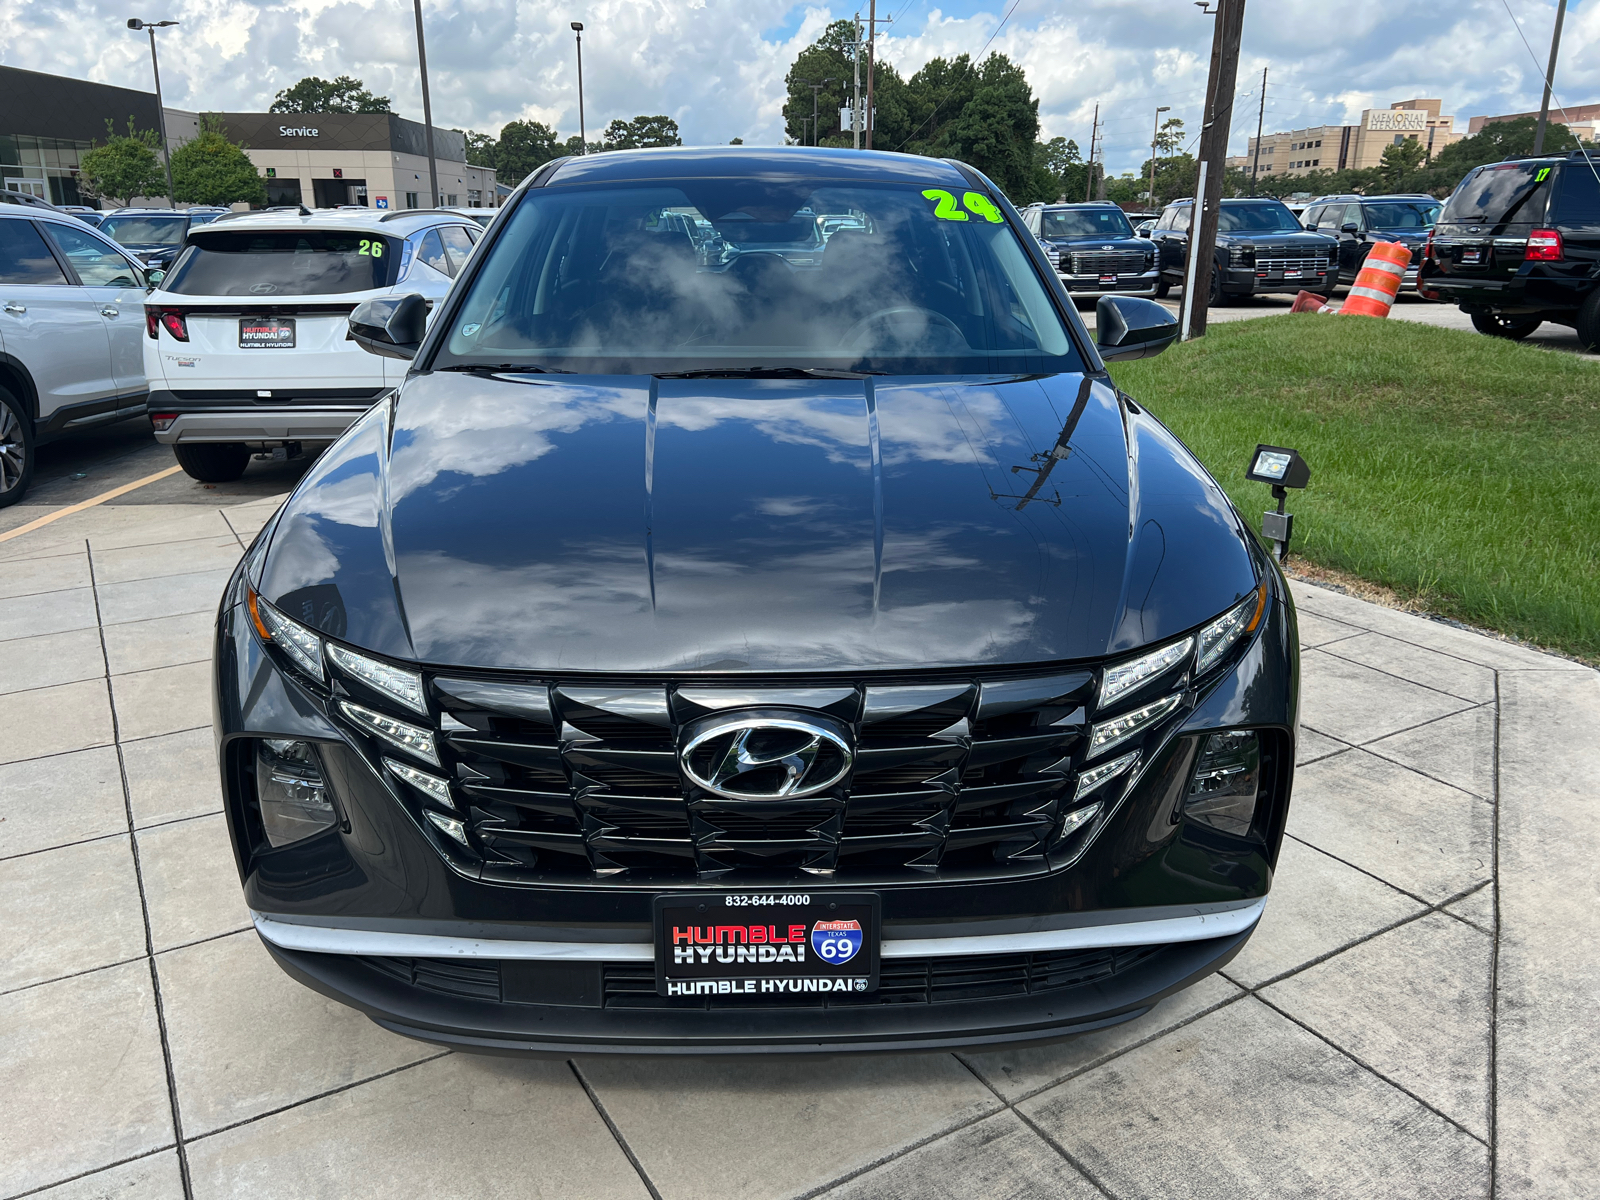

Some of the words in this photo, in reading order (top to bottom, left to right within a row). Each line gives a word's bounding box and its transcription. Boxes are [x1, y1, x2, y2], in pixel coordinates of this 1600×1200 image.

[1370, 121, 1423, 129] HERMANN
[1371, 114, 1424, 122] MEMORIAL
[279, 126, 319, 137] Service
[1534, 167, 1551, 182] 17
[921, 189, 1004, 224] 24
[358, 239, 383, 258] 26
[725, 895, 810, 906] 832-644-4000
[819, 922, 855, 930] INTERSTATE
[673, 925, 806, 944] HUMBLE
[674, 944, 805, 964] HYUNDAI
[820, 939, 853, 959] 69
[667, 980, 757, 996] HUMBLE
[761, 979, 852, 992] HYUNDAI
